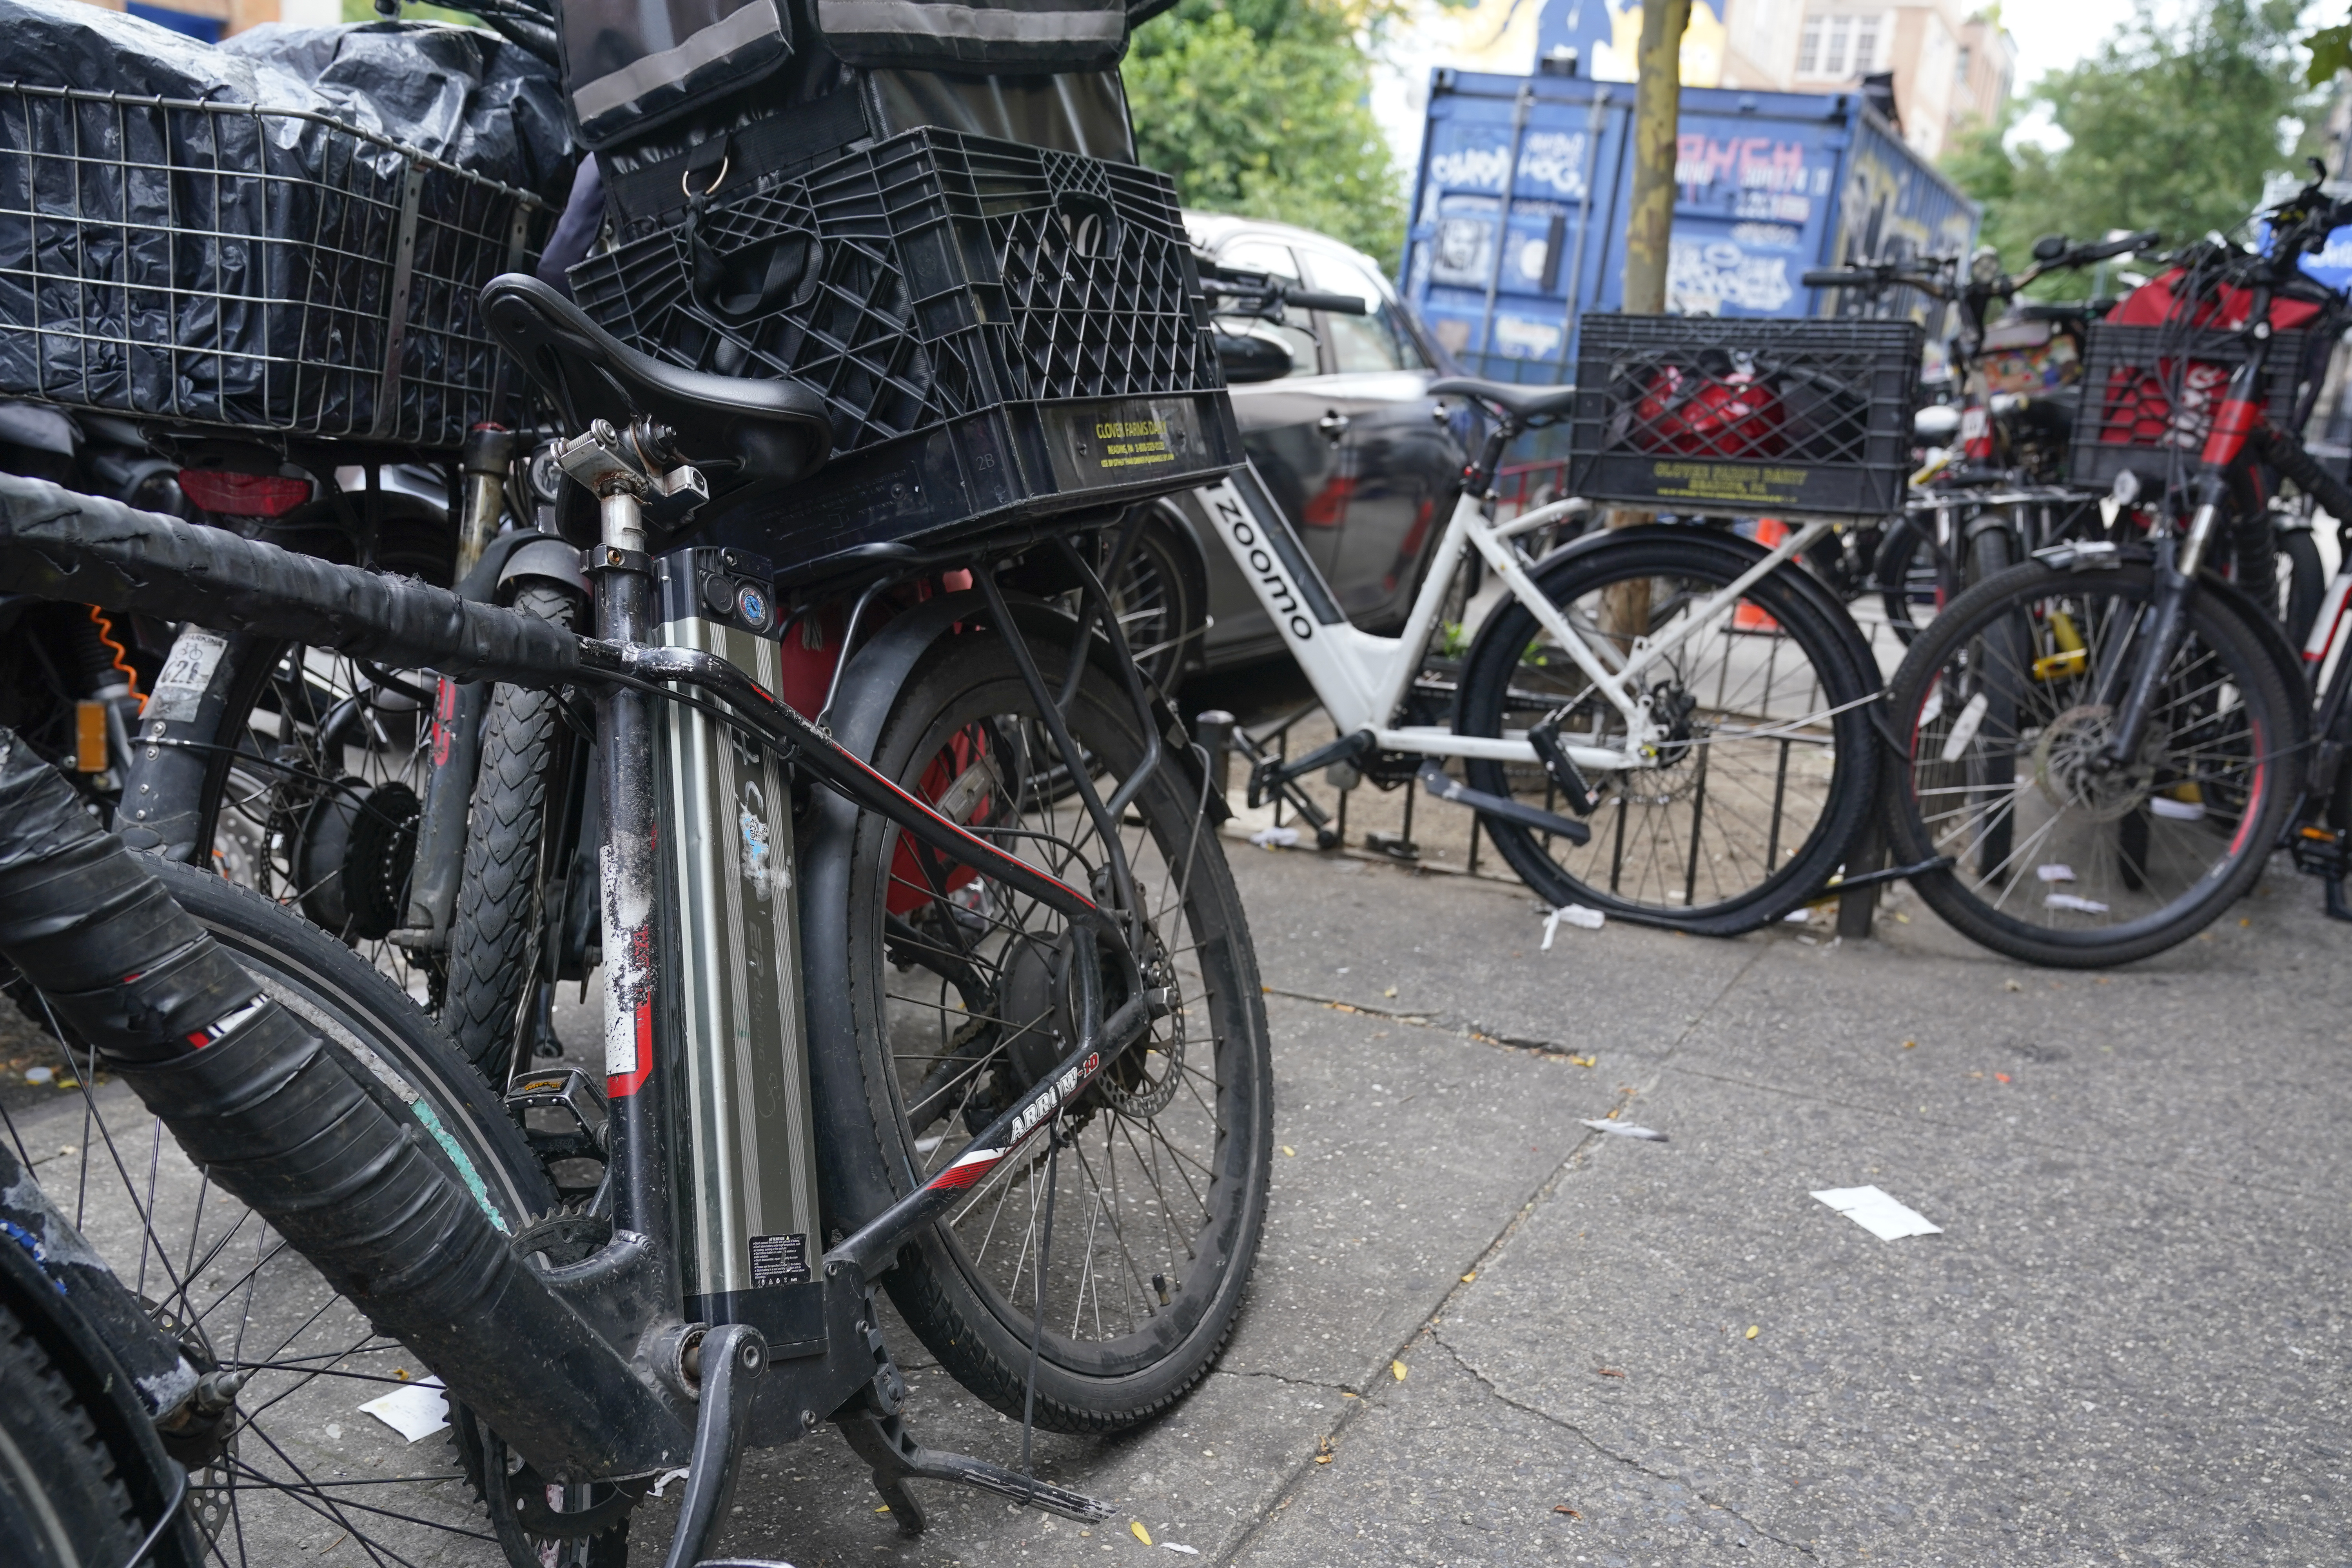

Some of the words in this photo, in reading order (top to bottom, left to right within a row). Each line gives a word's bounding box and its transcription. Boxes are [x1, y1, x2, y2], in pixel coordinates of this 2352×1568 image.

[1096, 423, 1125, 439] CLOVER
[1124, 421, 1149, 437] FARMS
[975, 453, 995, 471] 2B
[1216, 498, 1312, 640] zoomo
